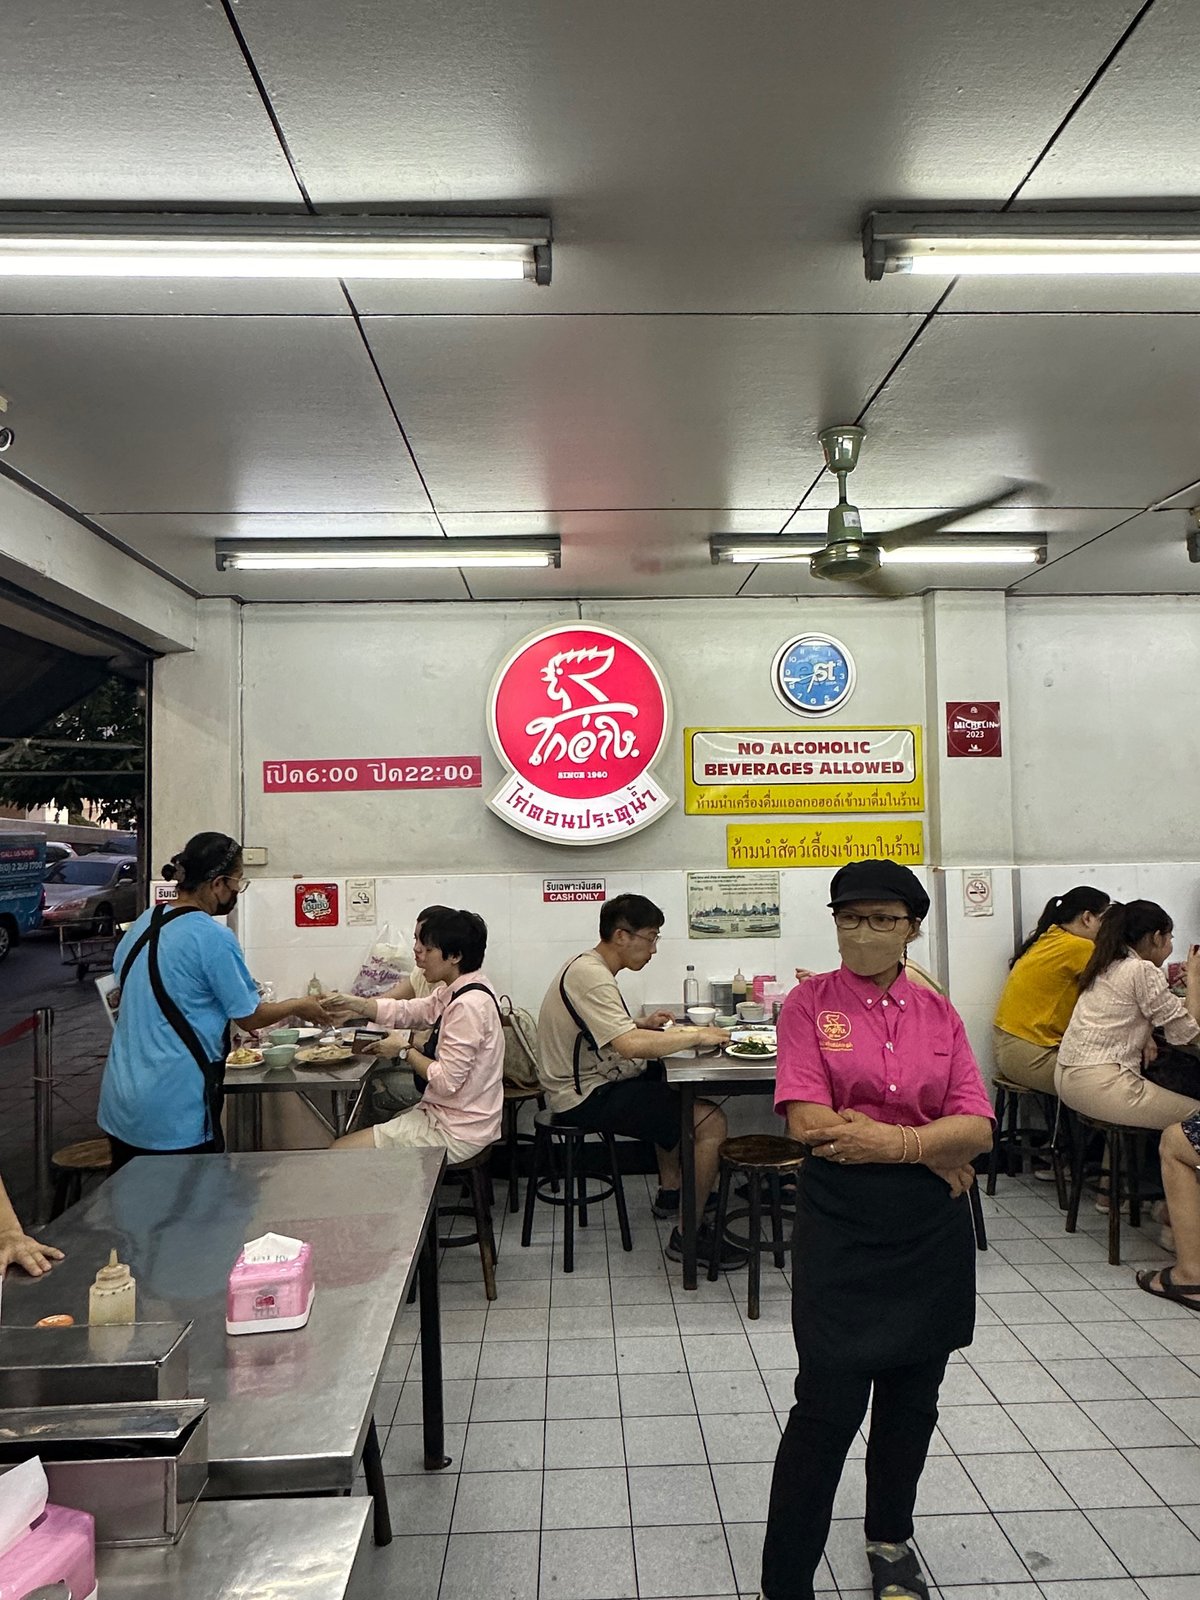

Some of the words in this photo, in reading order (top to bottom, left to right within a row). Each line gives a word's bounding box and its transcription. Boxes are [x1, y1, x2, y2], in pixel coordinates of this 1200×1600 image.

[954, 721, 995, 729] MICHELIN
[738, 742, 764, 755] NO
[771, 741, 871, 755] ALCOHOLIC
[558, 771, 585, 779] SINCE
[587, 771, 608, 779] 1960
[704, 762, 813, 776] BEVERAGES
[819, 761, 904, 774] ALLOWED
[506, 781, 658, 829] ไก่ตอนประตูน้ำ
[696, 788, 921, 809] ห้ามนำเครื่องดื่มแอลกอฮอล์เข้ามาดื่มในร้าน
[731, 831, 920, 859] ห้ามนำสัตว์เลี้ยงเข้ามาในร้าน
[546, 881, 602, 891] รับเฉพาะเงินสด
[549, 893, 574, 901] CASH
